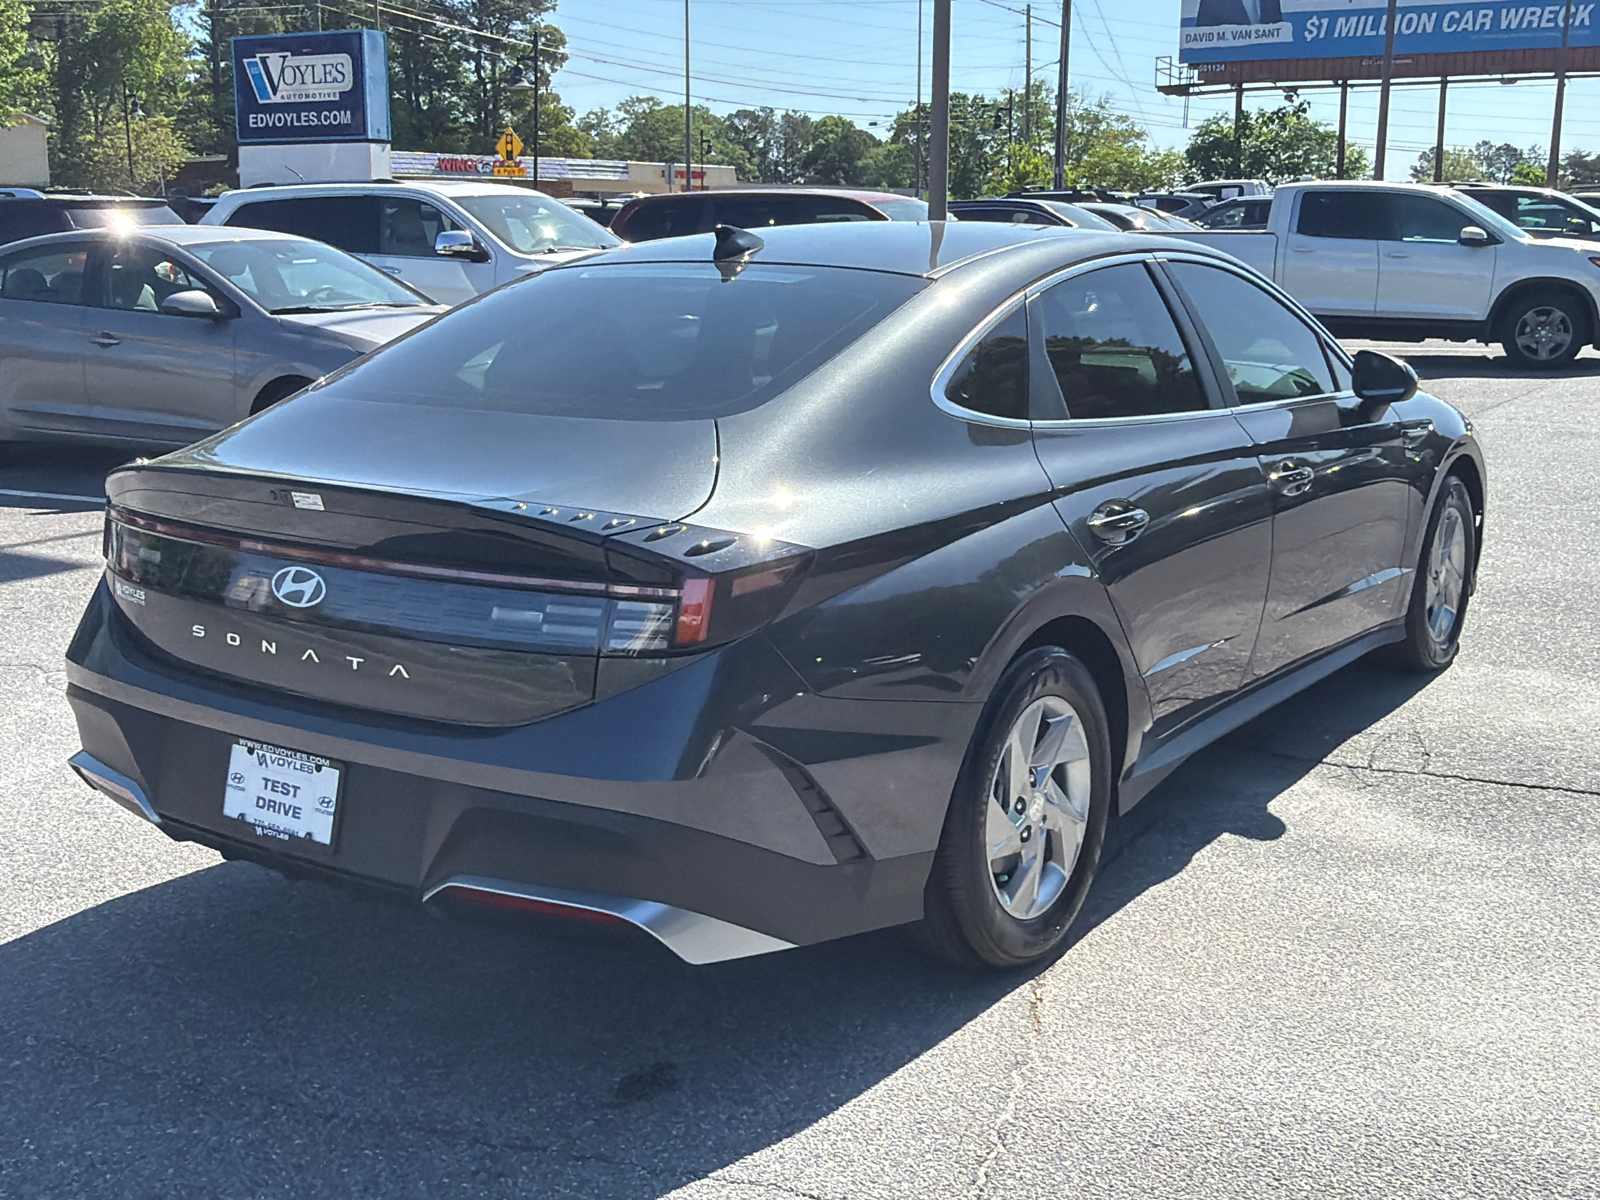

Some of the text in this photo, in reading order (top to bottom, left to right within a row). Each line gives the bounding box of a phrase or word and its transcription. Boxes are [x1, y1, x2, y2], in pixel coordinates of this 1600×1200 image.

[1304, 3, 1596, 42] $1 MILLION CAR WRECK
[1185, 27, 1282, 44] DAVID M. VAN SANT
[258, 55, 346, 97] VOYLES
[280, 91, 338, 100] AUTOMOTIVE
[249, 110, 351, 128] EDVOYLES.COM
[192, 624, 410, 679] SONATA
[239, 738, 330, 767] WWW.EDVOYLES.COM
[269, 755, 315, 775] VOYLES
[262, 777, 301, 798] TEST
[255, 796, 302, 820] DRIVE
